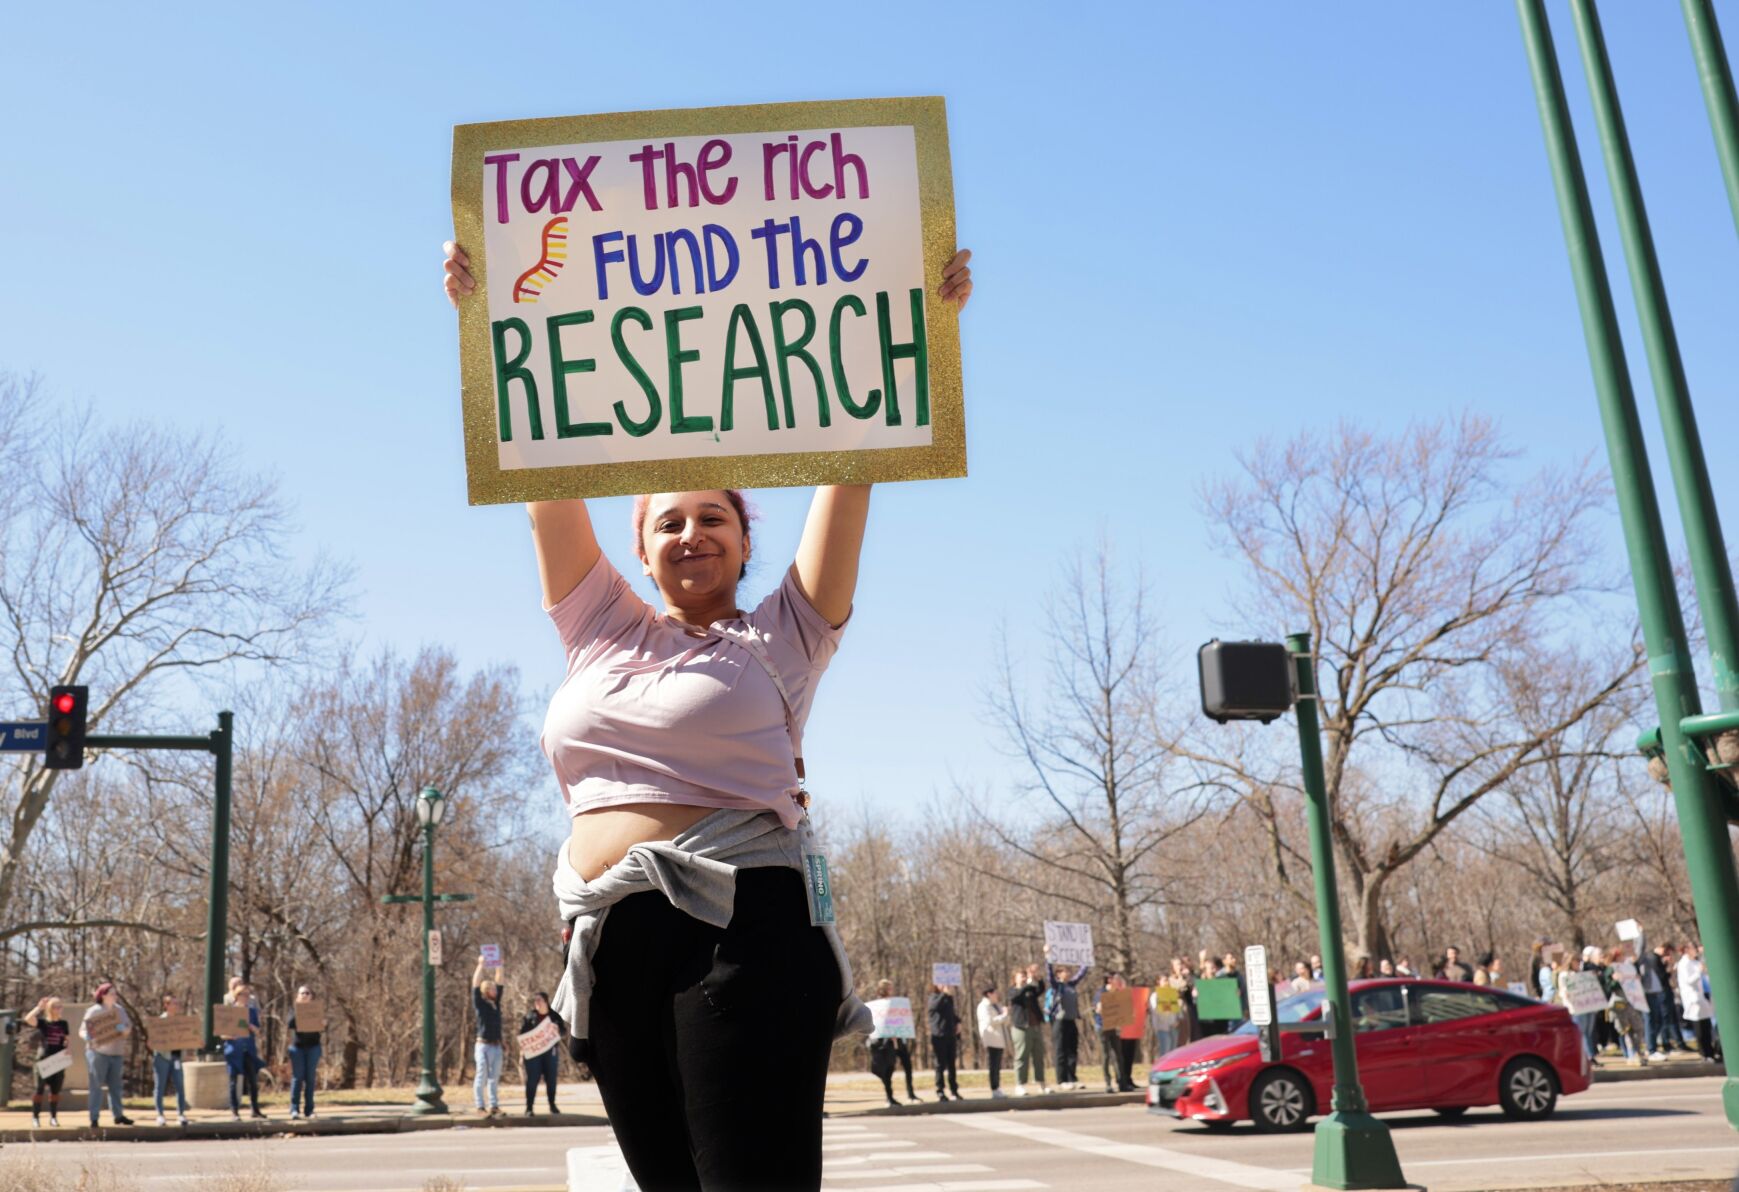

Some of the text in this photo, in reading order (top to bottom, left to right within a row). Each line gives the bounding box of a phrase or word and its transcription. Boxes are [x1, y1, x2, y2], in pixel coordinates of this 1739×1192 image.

[484, 132, 870, 224] Tax the rich
[751, 212, 870, 290] the
[491, 288, 931, 442] RESEARCH
[14, 728, 39, 740] Blvd
[1051, 944, 1092, 965] SCIENCE
